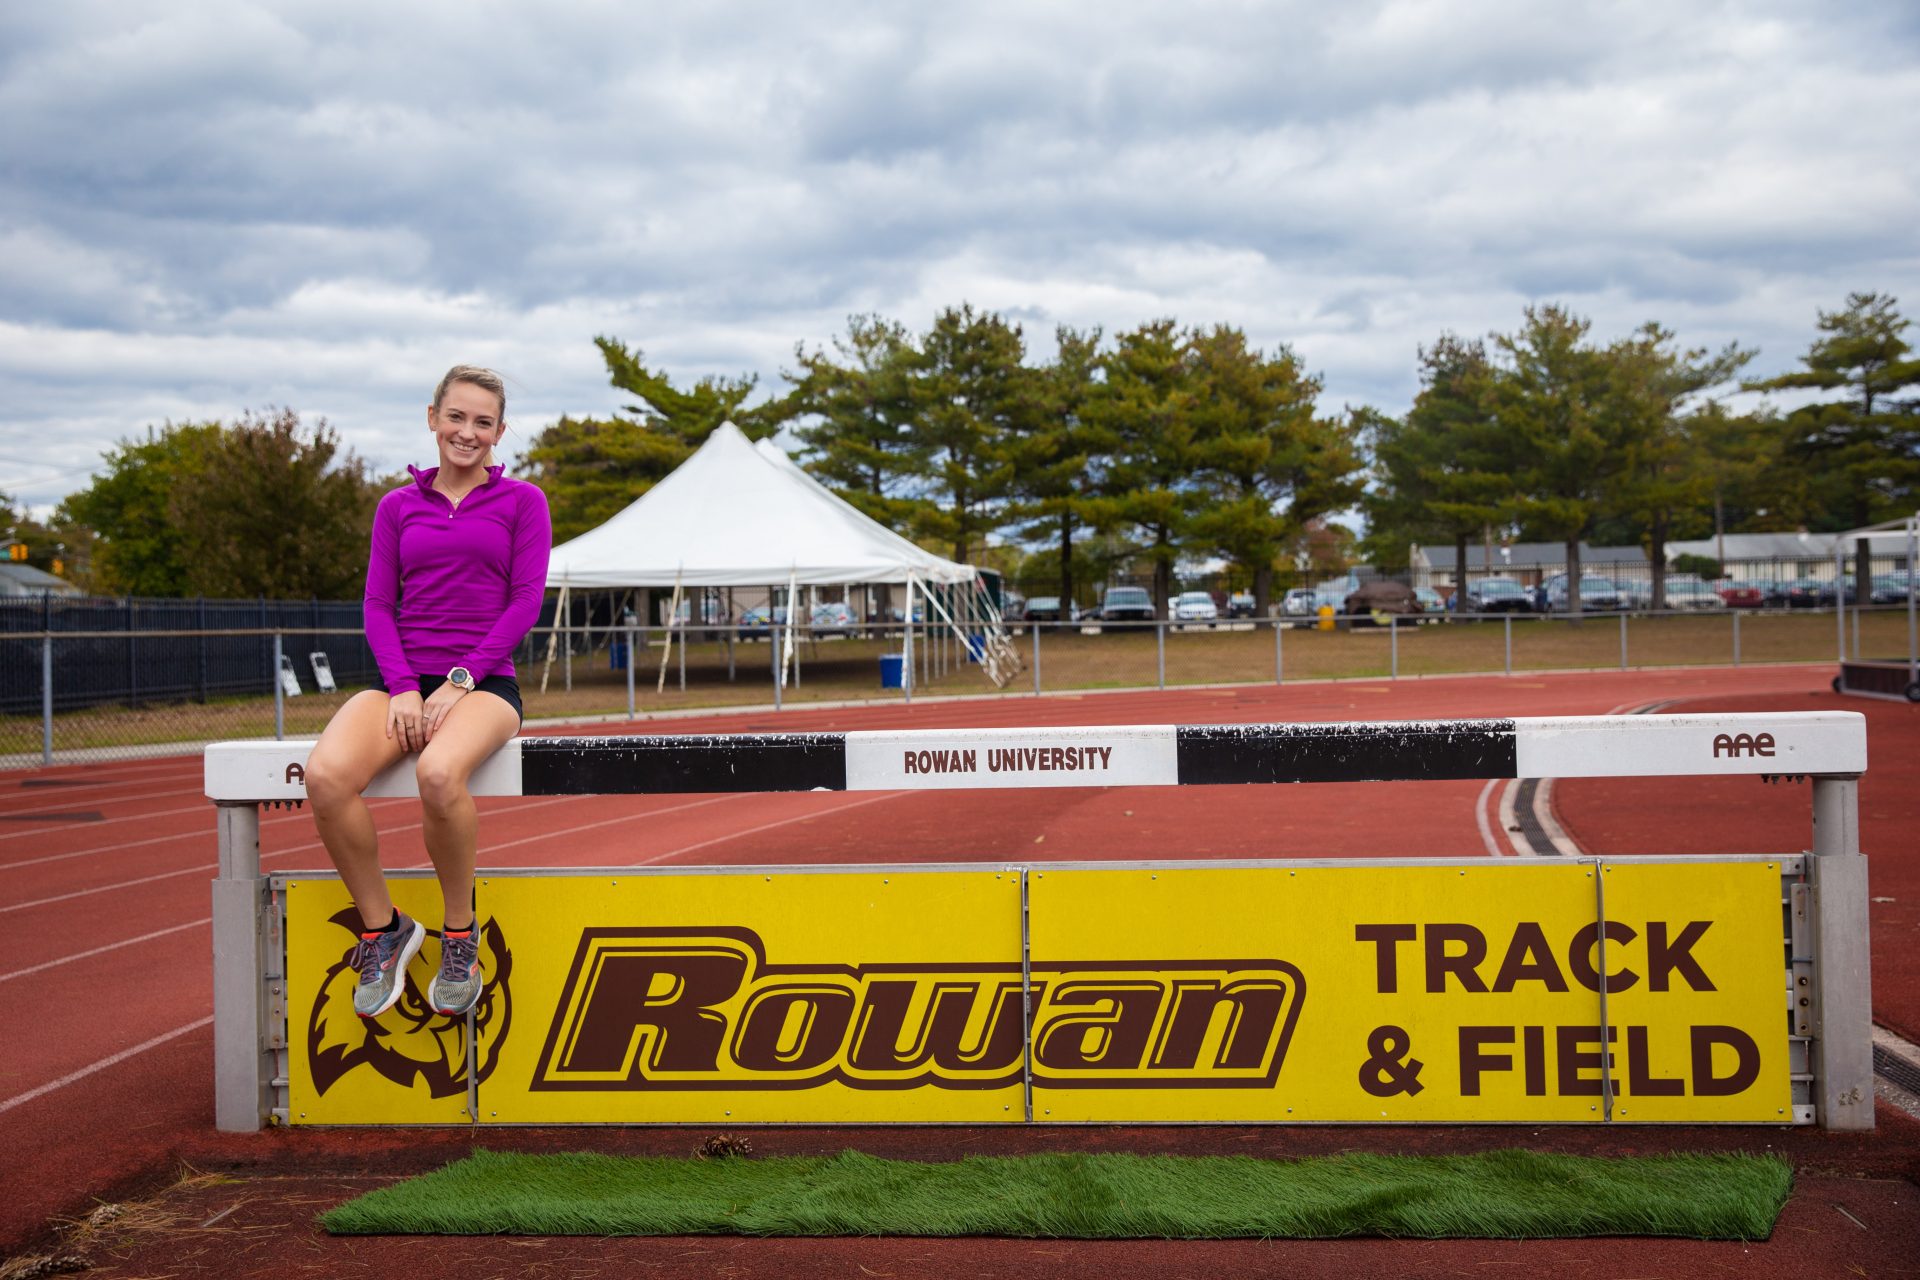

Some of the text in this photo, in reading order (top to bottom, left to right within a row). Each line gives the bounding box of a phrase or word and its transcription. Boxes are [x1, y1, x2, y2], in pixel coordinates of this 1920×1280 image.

[905, 746, 1112, 773] ROWAN UNIVERSITY
[1355, 920, 1717, 994] TRACK
[1359, 1024, 1760, 1098] & FIELD
